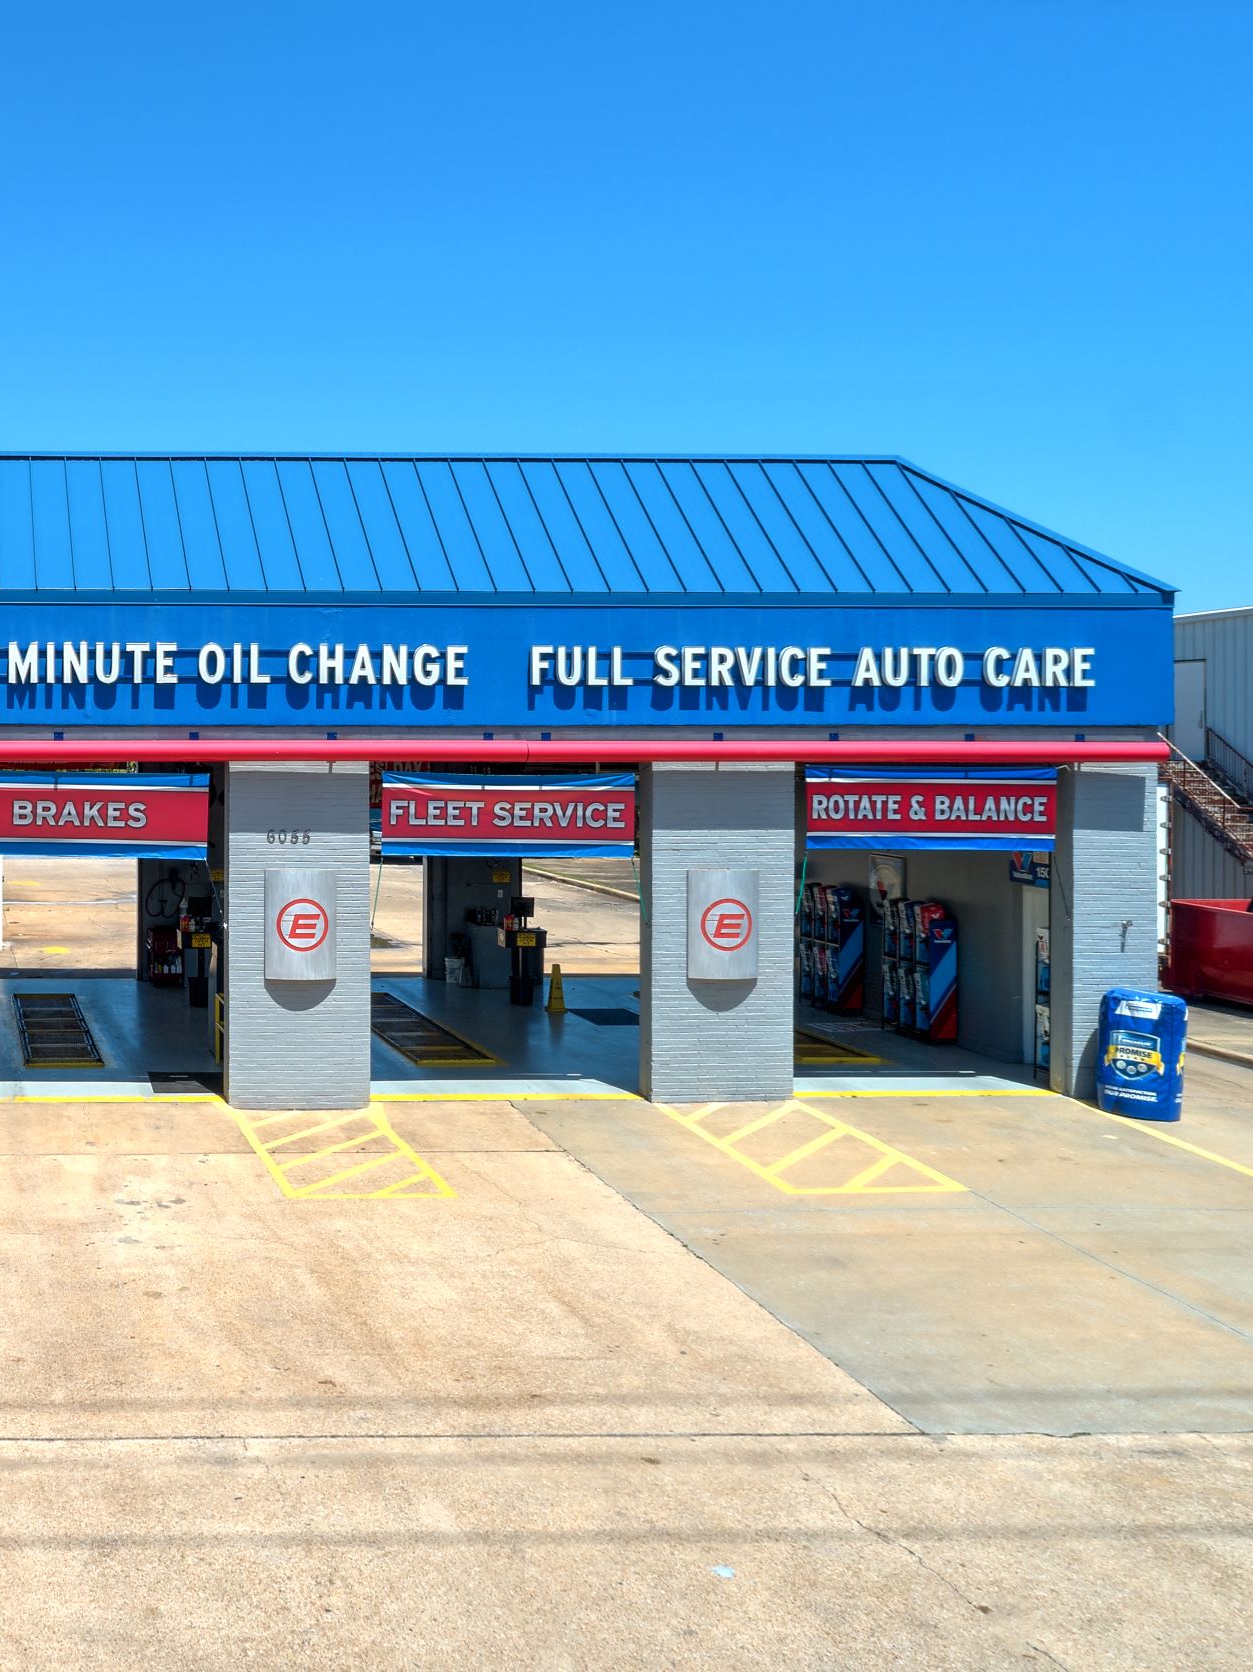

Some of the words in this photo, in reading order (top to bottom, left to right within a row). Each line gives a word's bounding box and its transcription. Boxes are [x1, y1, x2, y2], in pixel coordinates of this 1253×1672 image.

[7, 640, 179, 685] MINUTE
[197, 641, 272, 685] OIL
[288, 642, 469, 687] CHANGE
[530, 644, 635, 687] FULL
[652, 645, 832, 688] SERVICE
[851, 646, 965, 688] AUTO
[982, 646, 1096, 688] CARE
[12, 799, 148, 829] BRAKES
[389, 799, 485, 827] FLEET
[492, 801, 626, 829] SERVICE
[811, 794, 902, 821] ROTATE
[909, 794, 927, 821] &
[934, 795, 1048, 823] BALANCE
[265, 828, 312, 845] 6055
[1114, 1046, 1153, 1059] PROMISE
